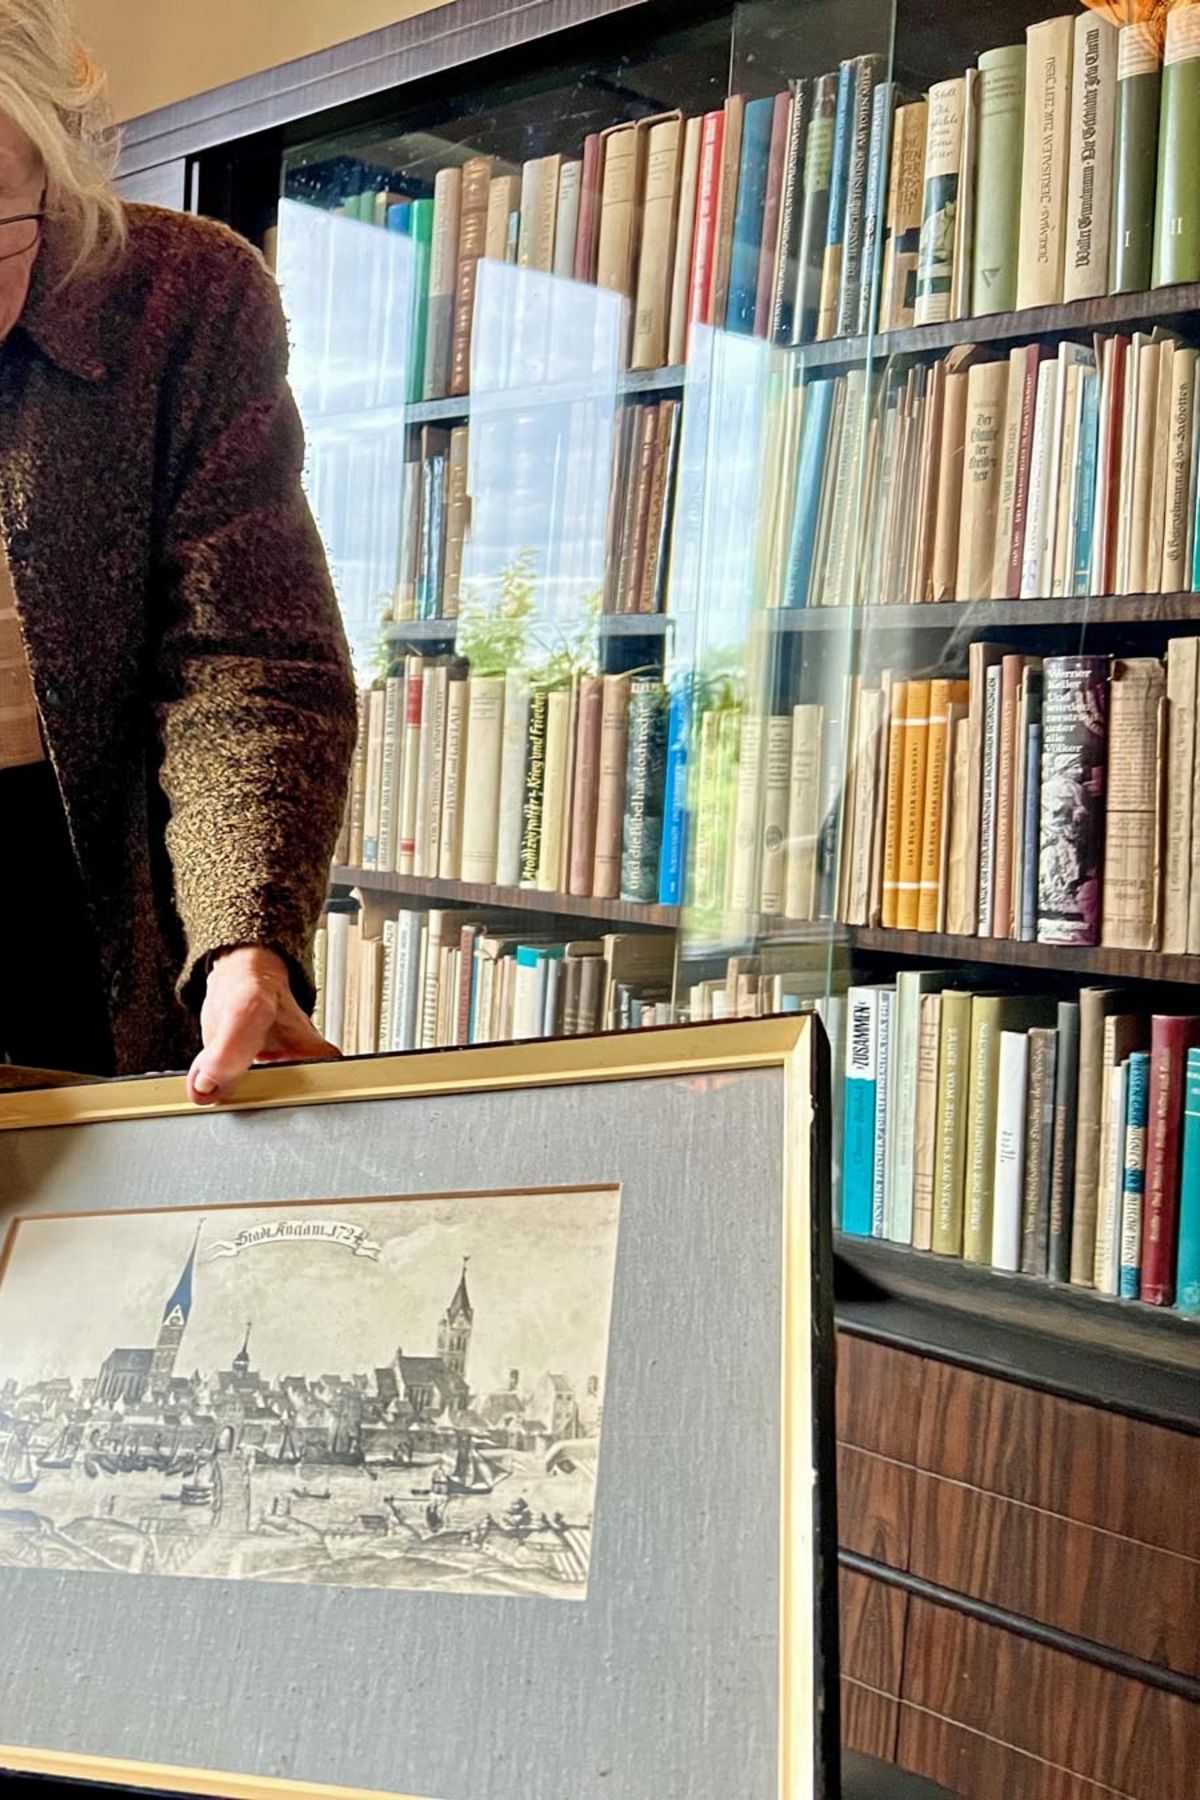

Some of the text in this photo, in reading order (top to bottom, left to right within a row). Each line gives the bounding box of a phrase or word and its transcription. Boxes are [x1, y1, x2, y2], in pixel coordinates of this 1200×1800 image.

[1037, 56, 1057, 263] JEREMIAS JERUSALEM ZUR ZEIT JESU
[1080, 140, 1097, 160] Die
[1078, 166, 1095, 228] Grundmann
[1076, 230, 1092, 267] Walter
[1047, 669, 1092, 677] Werner
[1048, 680, 1082, 688] Keller
[1047, 691, 1071, 702] Und
[632, 742, 647, 776] doch
[1045, 744, 1083, 752] Völker
[629, 801, 643, 835] Bibel
[909, 799, 918, 817] DER
[930, 799, 938, 817] DER
[907, 819, 916, 846] BUCH
[928, 820, 938, 846] BUCH
[628, 836, 641, 858] die
[927, 848, 936, 866] DAS
[940, 1027, 957, 1231] SAUER VOM ADEL DES MENSCHEN
